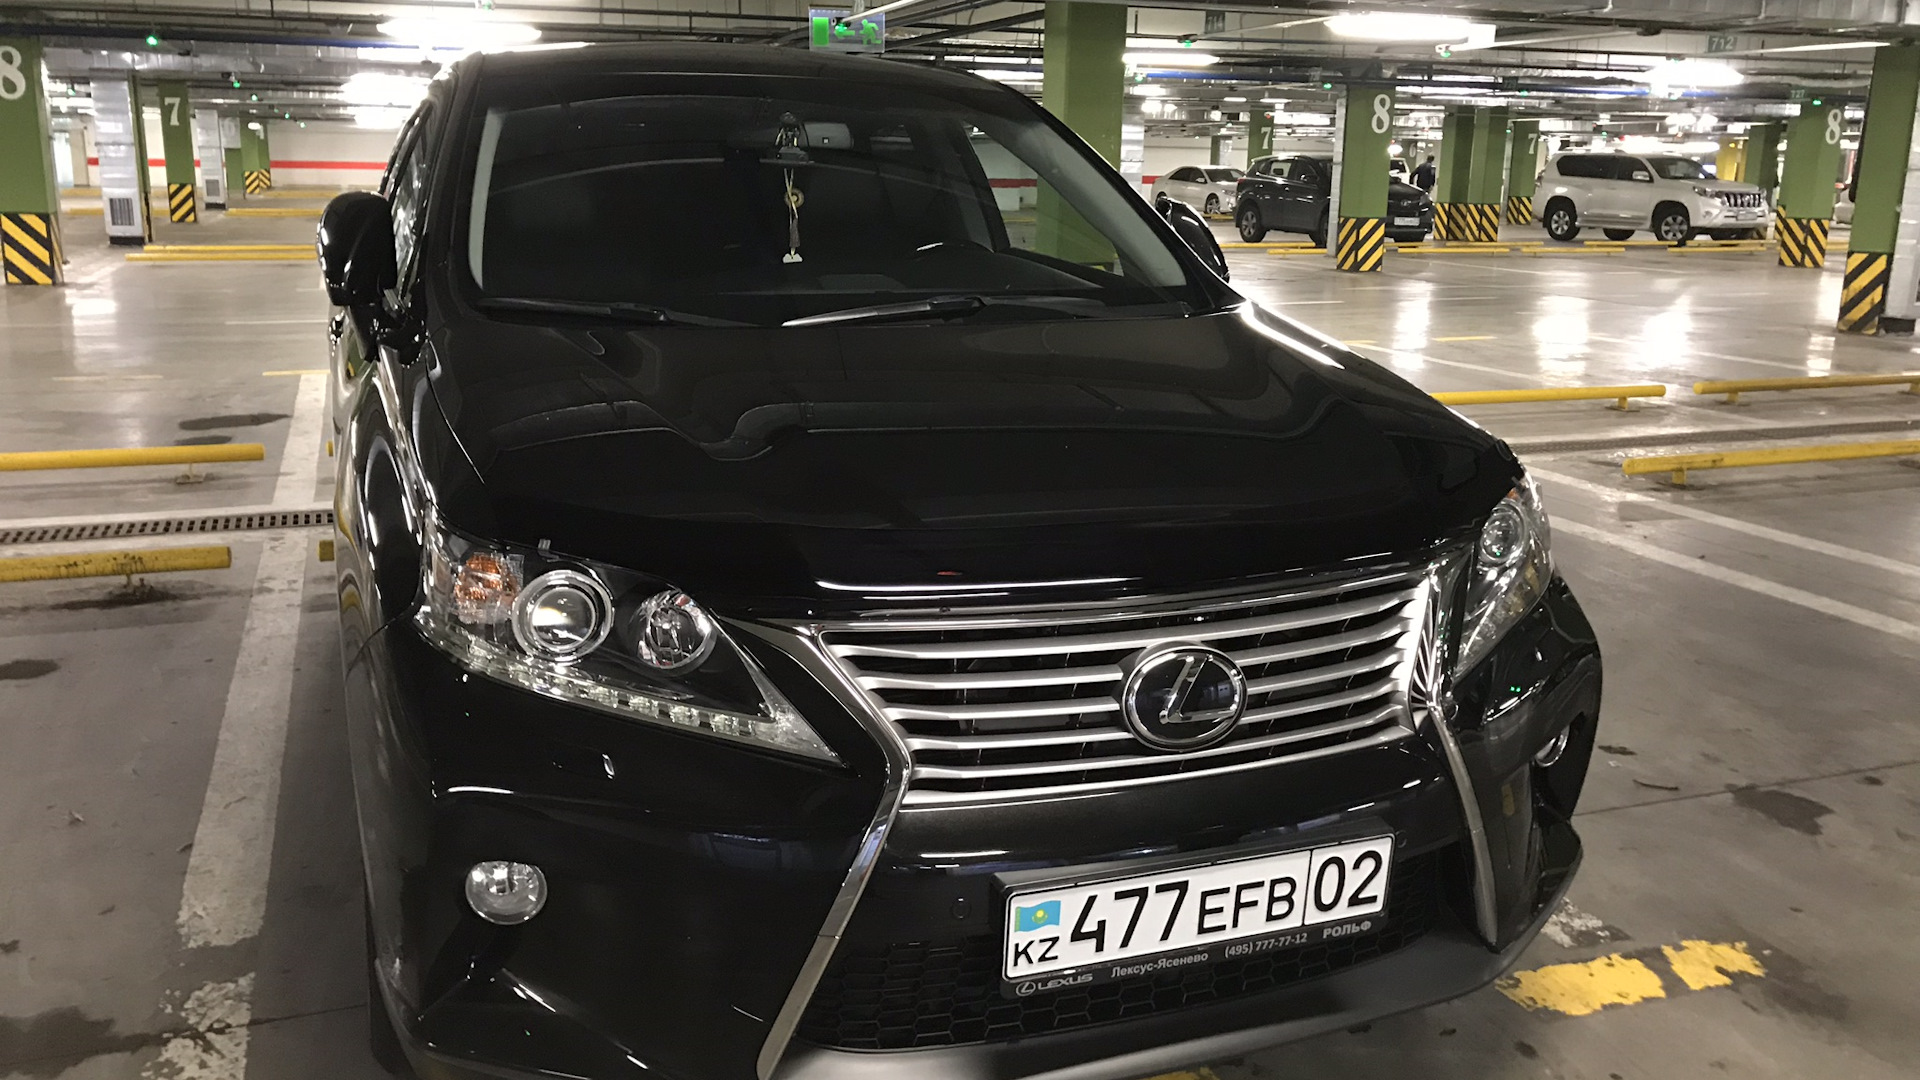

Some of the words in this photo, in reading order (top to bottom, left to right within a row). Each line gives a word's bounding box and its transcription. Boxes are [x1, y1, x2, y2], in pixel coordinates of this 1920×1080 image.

[1711, 36, 1734, 51] 712
[0, 45, 26, 100] 8
[164, 97, 181, 126] 7
[1371, 93, 1391, 134] 8
[1261, 126, 1272, 150] 7
[1825, 108, 1842, 145] 8
[1528, 133, 1538, 155] 7
[1322, 920, 1372, 939] РОЛЬФ
[1013, 936, 1060, 967] KZ
[1224, 941, 1253, 959] (495)
[1255, 932, 1308, 952] 777-77-12
[1111, 952, 1209, 978] Лексус-Ясенево
[1037, 973, 1093, 990] LEXUS
